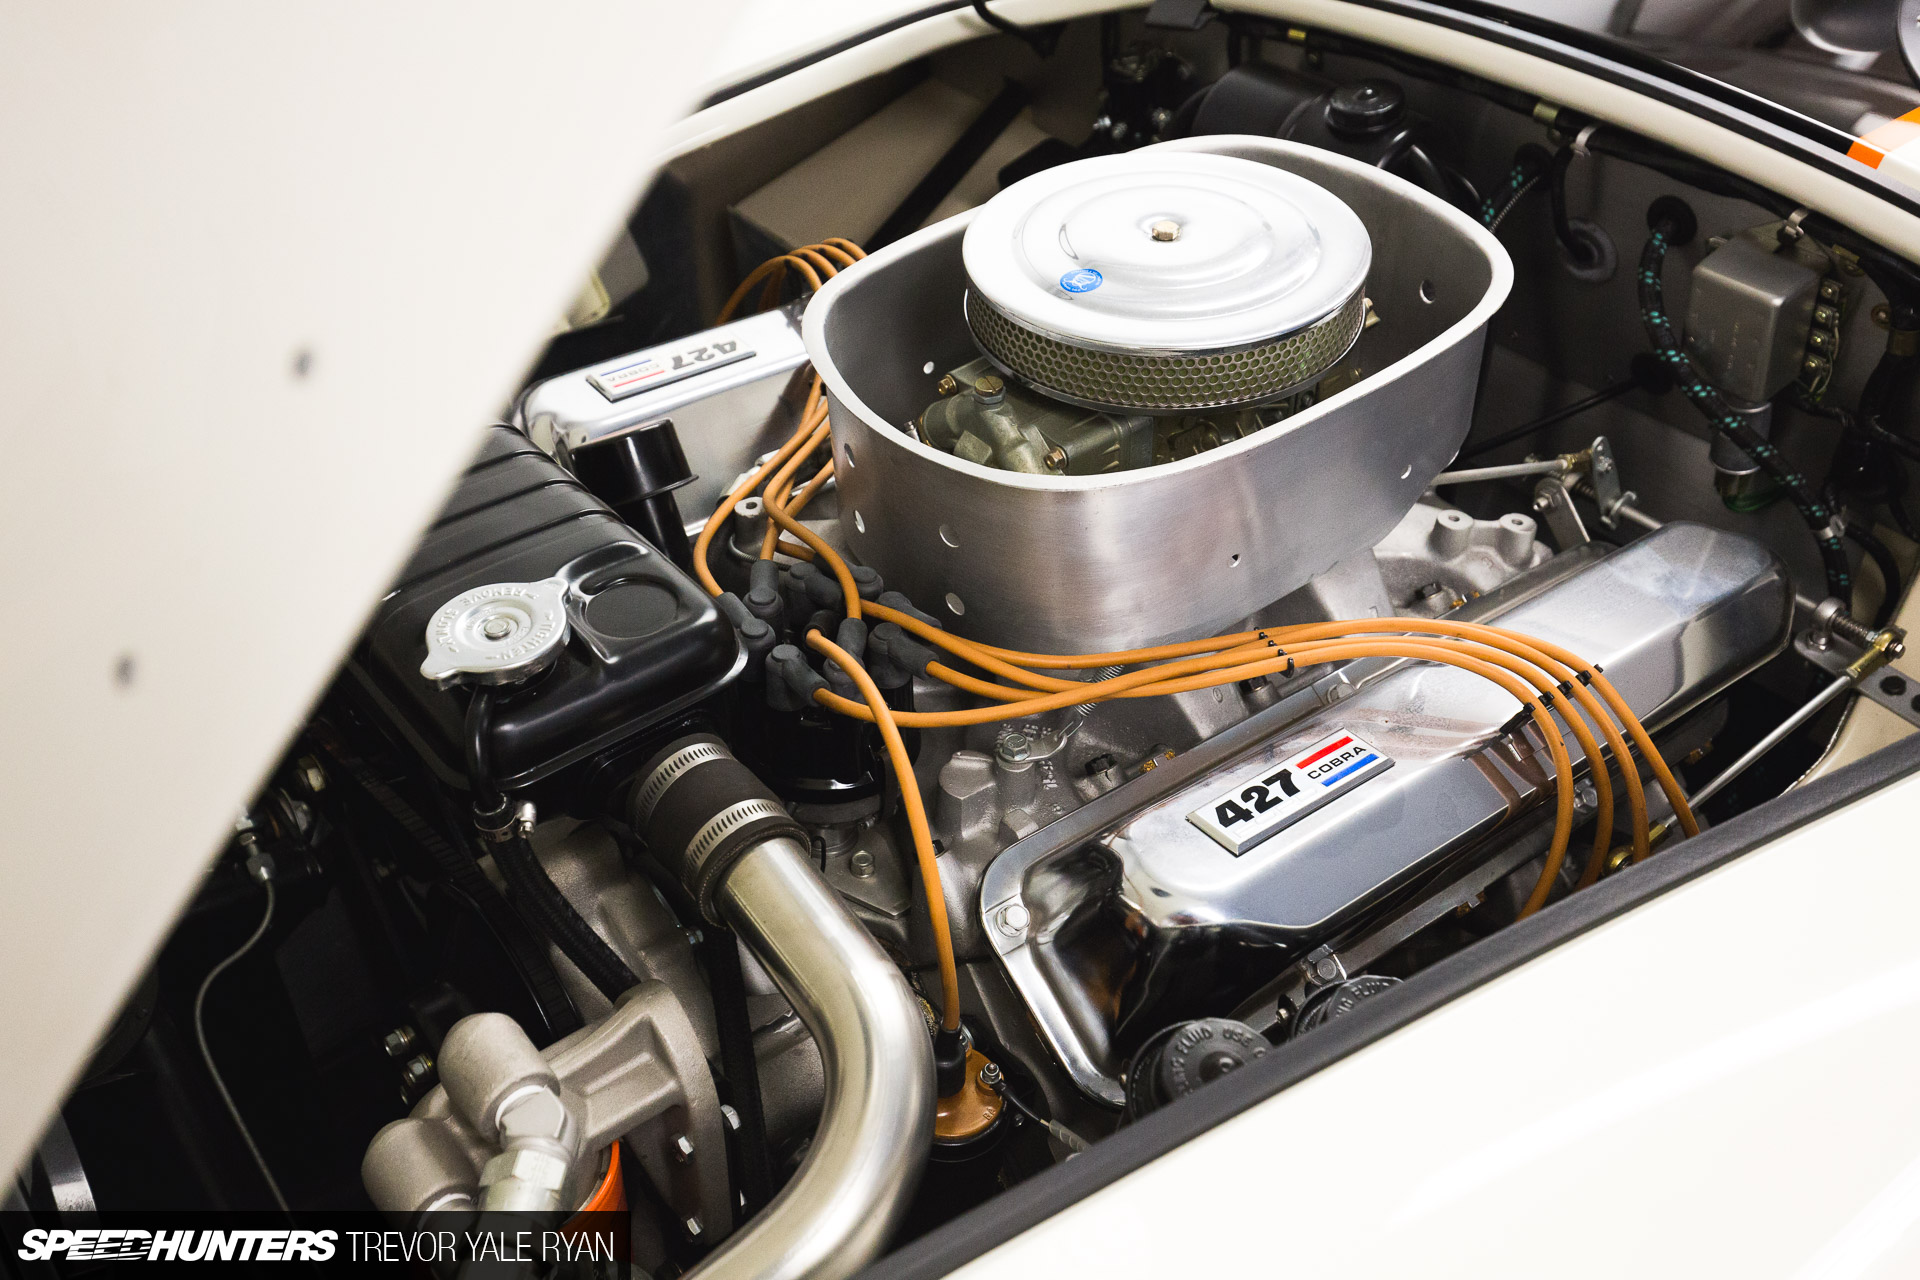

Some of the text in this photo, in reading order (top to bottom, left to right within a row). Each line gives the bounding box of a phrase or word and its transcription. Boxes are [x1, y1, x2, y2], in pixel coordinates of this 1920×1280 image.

[606, 340, 737, 382] 427 COBRA
[1215, 746, 1366, 828] 427 COBRA
